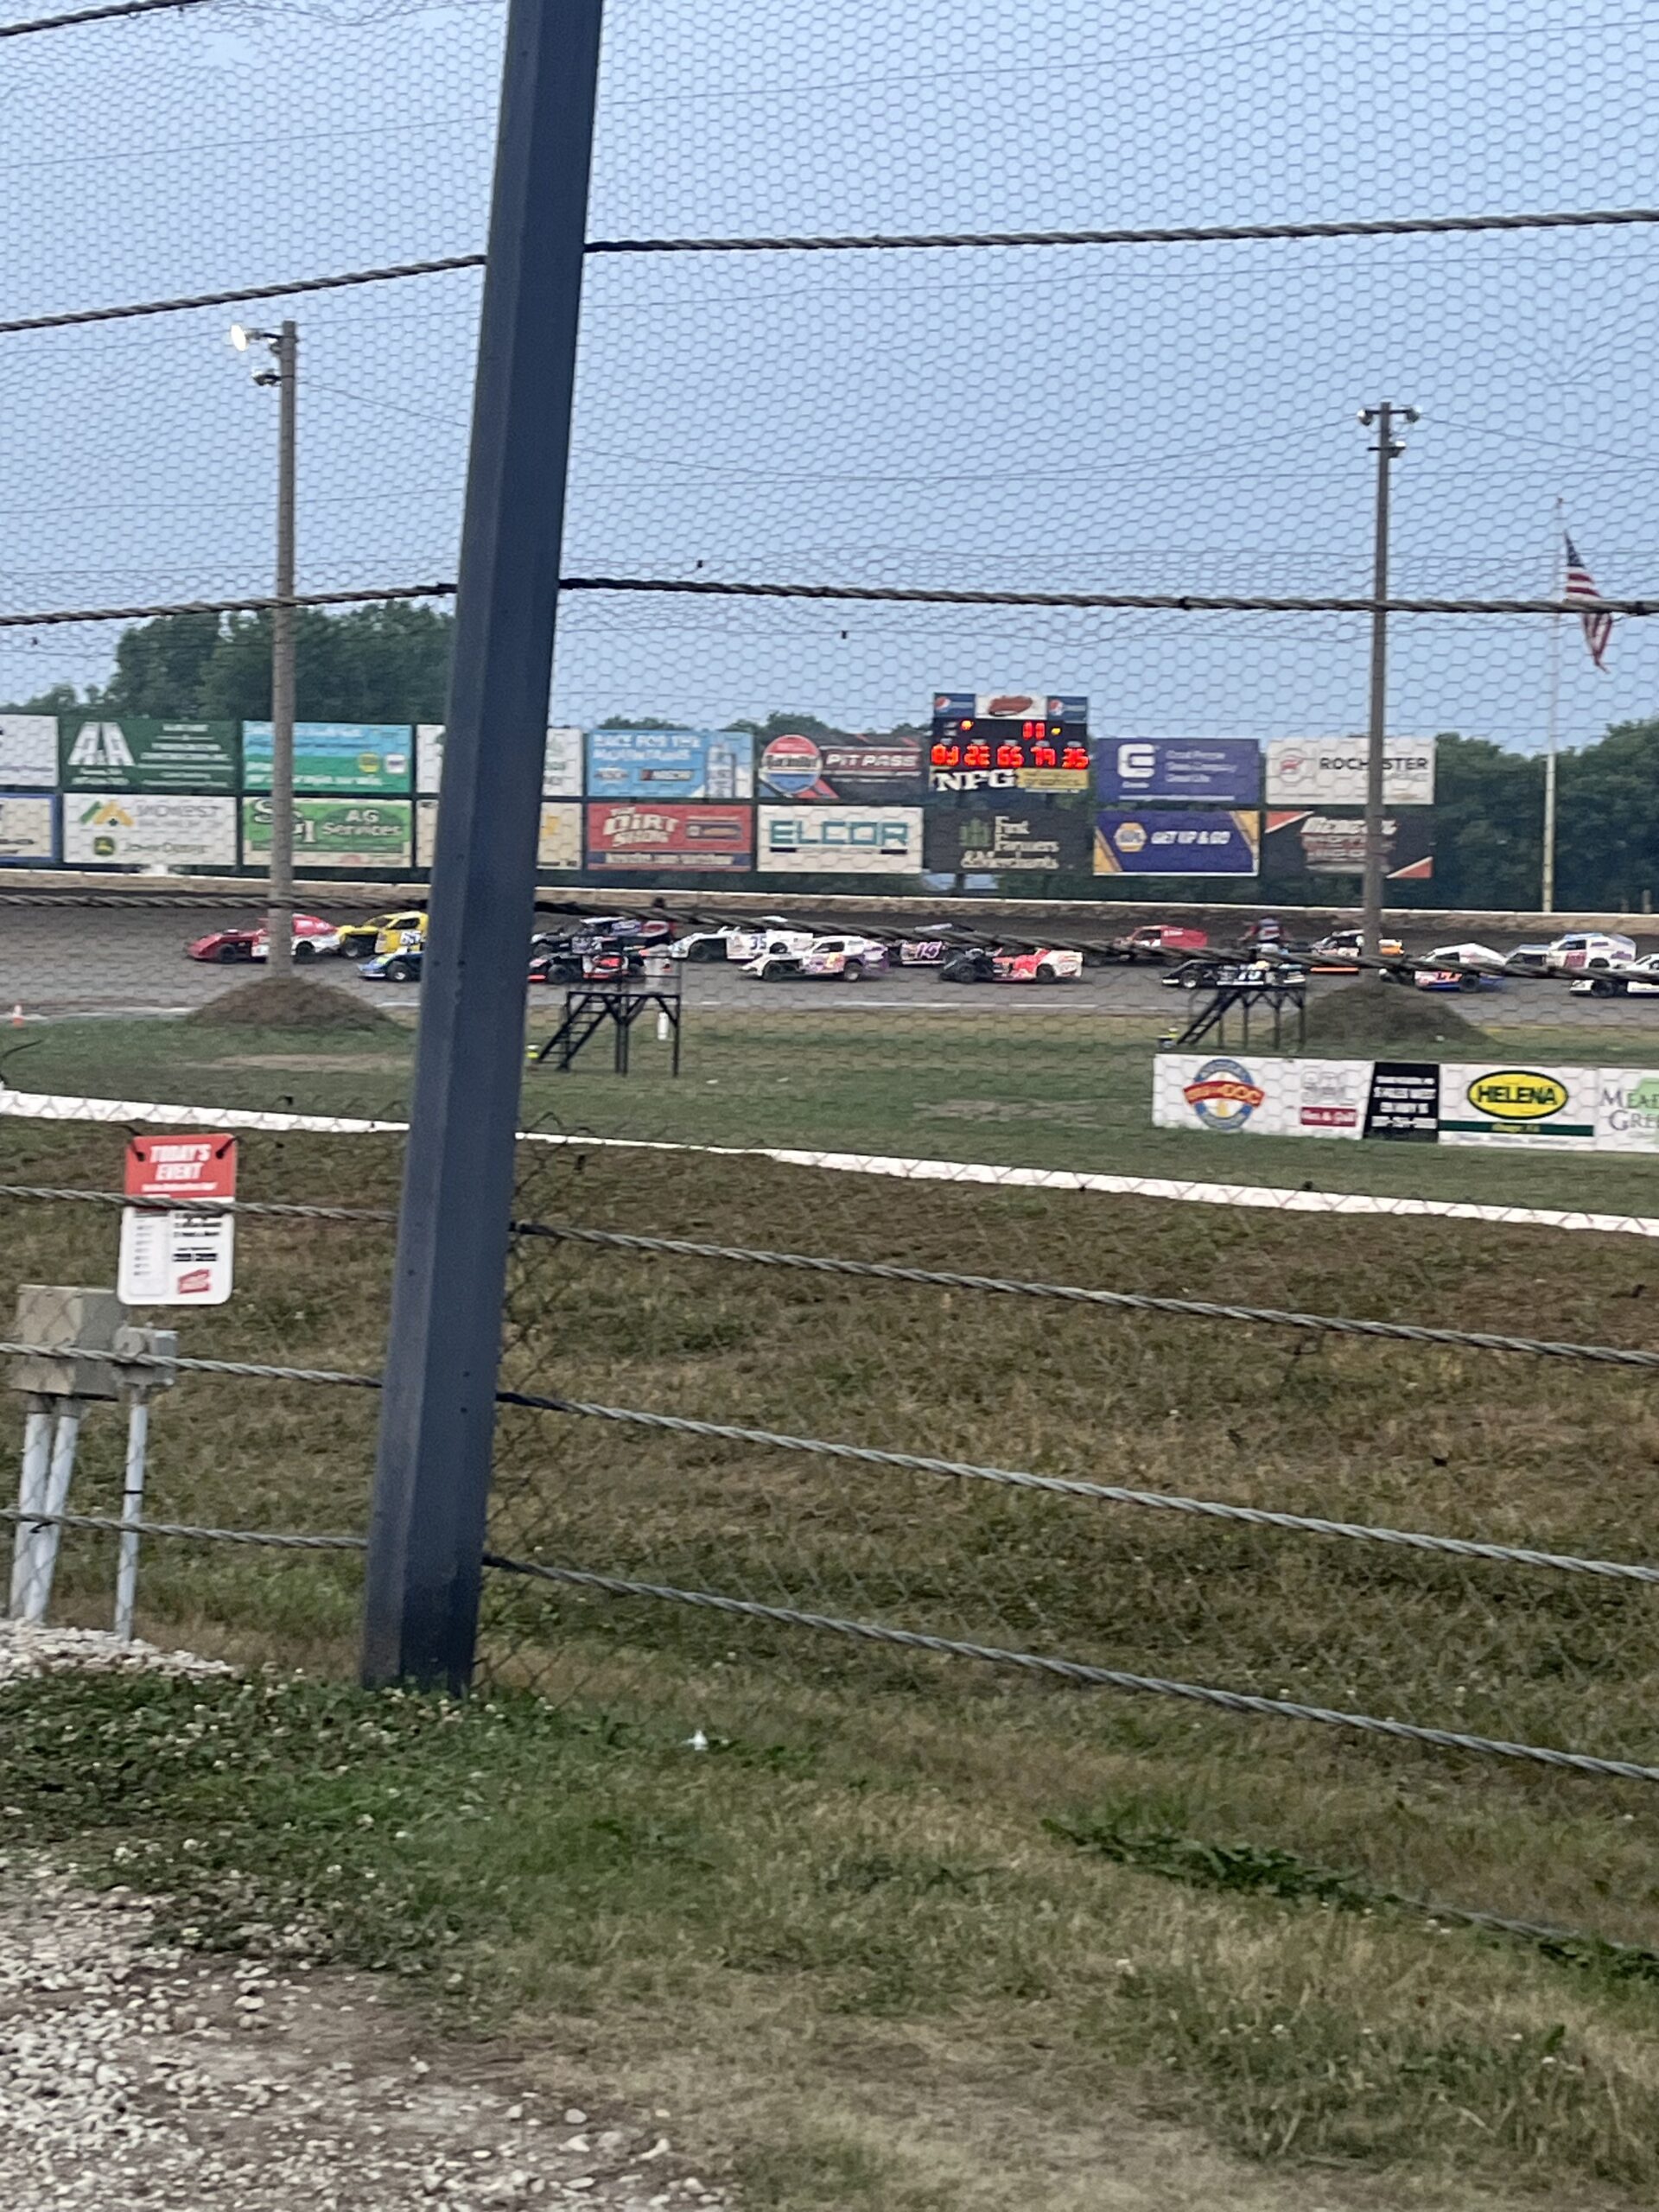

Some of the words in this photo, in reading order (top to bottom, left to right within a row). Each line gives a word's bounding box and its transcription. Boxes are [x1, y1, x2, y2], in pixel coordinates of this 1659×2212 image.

[861, 754, 918, 767] PASS
[346, 808, 380, 823] AG
[321, 821, 403, 836] Services
[770, 820, 909, 847] ELCOR
[1477, 1085, 1558, 1106] HELENA
